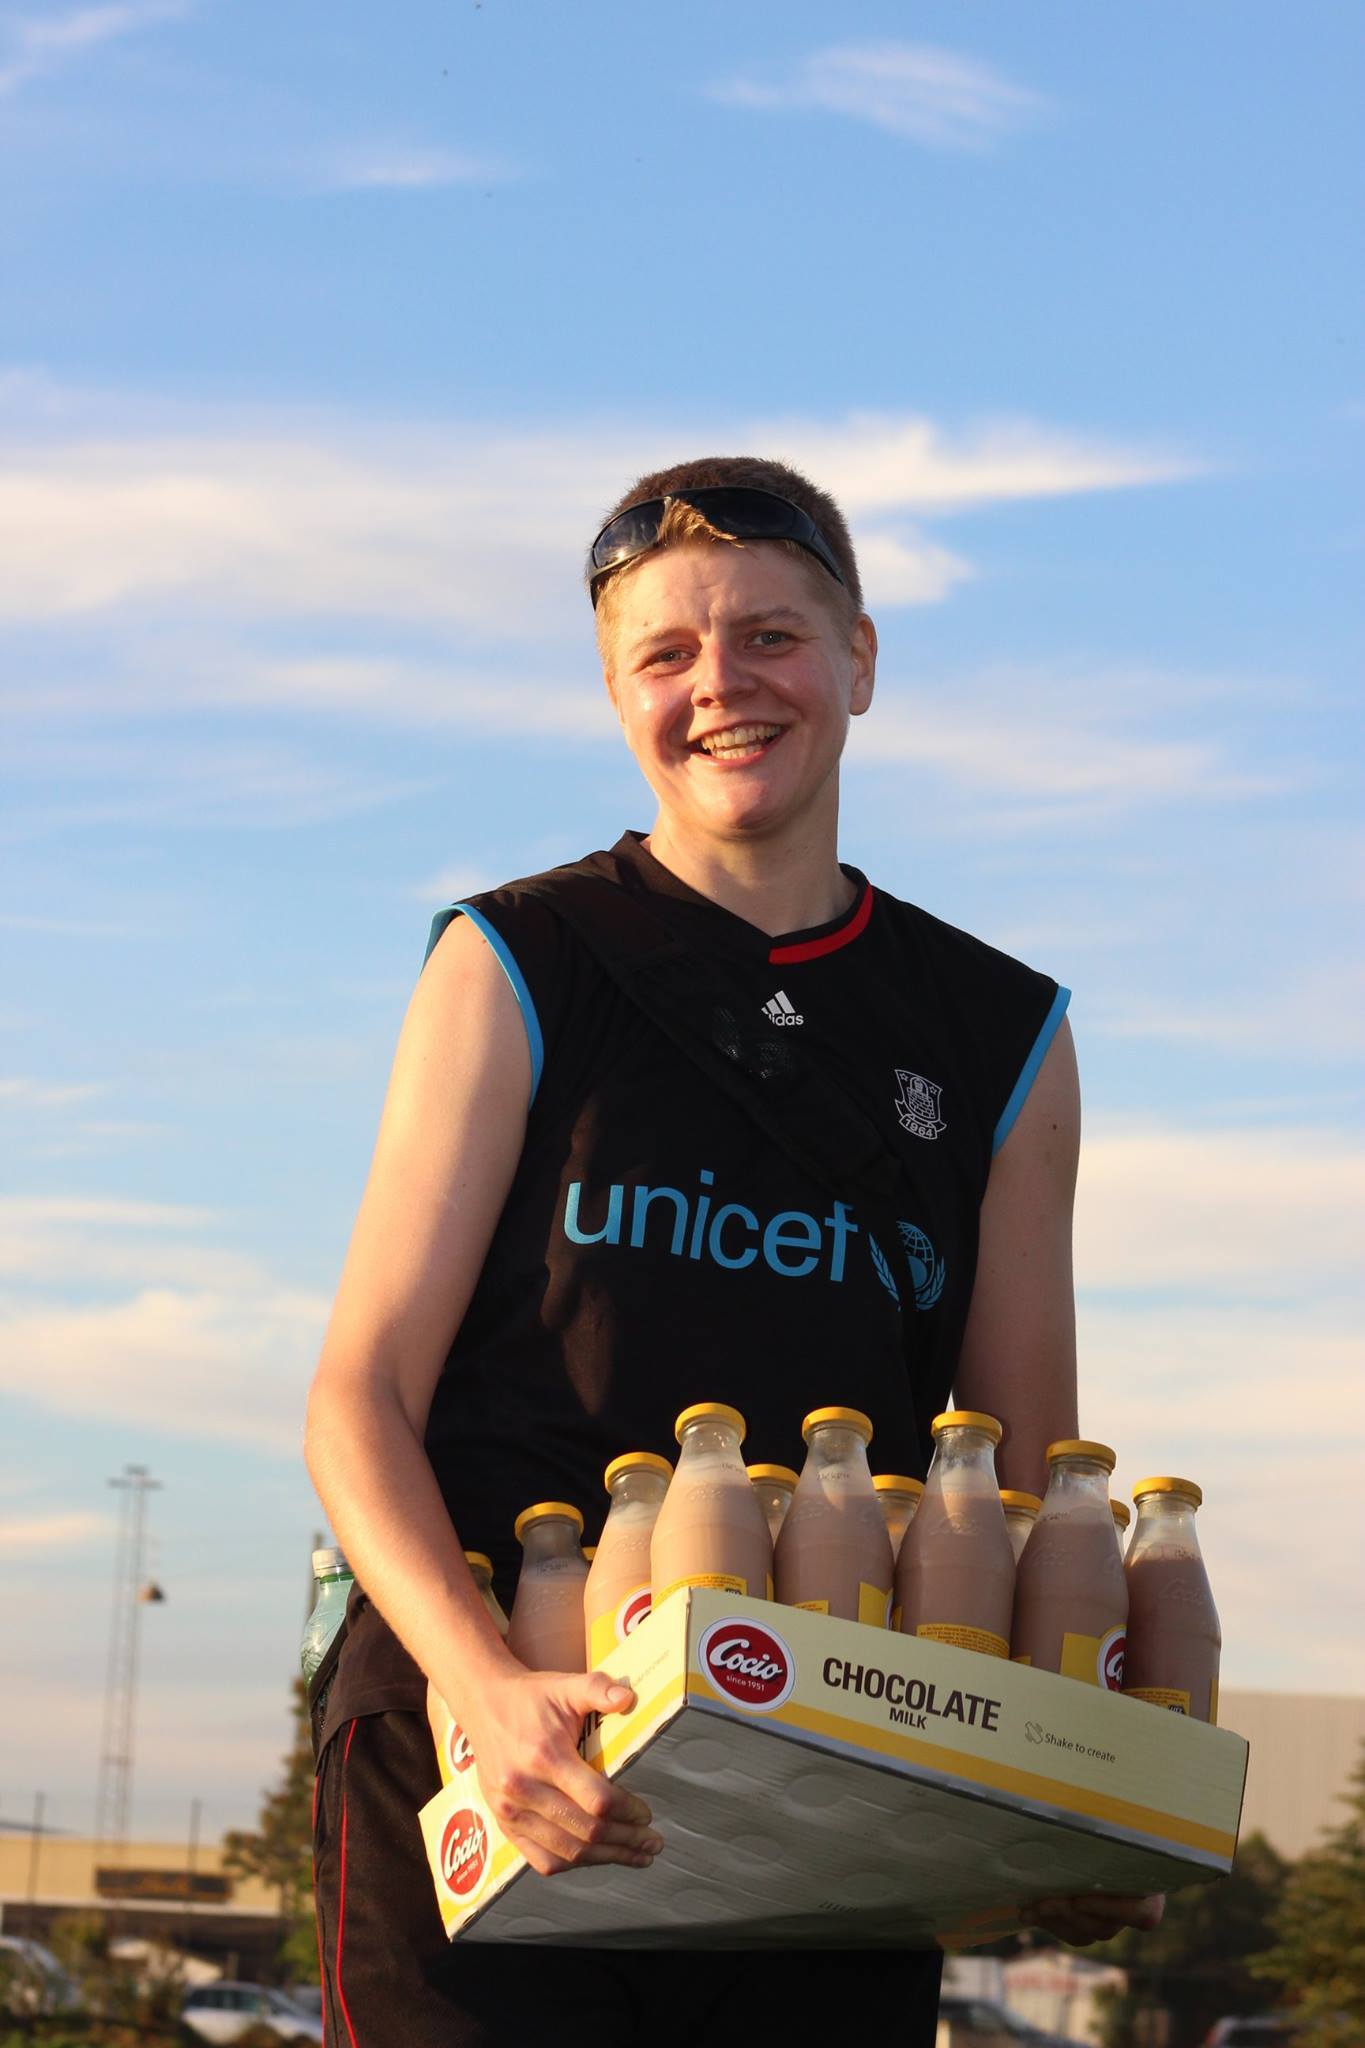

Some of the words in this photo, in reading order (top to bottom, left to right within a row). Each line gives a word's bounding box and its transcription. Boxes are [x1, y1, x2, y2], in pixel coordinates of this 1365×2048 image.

[905, 1118, 933, 1138] 1964
[564, 1169, 859, 1283] unicef
[709, 1638, 783, 1680] Cocio
[726, 1675, 746, 1686] since
[747, 1680, 765, 1692] 1951
[822, 1657, 1002, 1732] CHOCOLATE
[889, 1707, 927, 1730] MILK
[1044, 1732, 1073, 1750] Shake
[1075, 1743, 1086, 1754] to
[1087, 1747, 1116, 1763] create
[444, 1827, 483, 1880] Cocio
